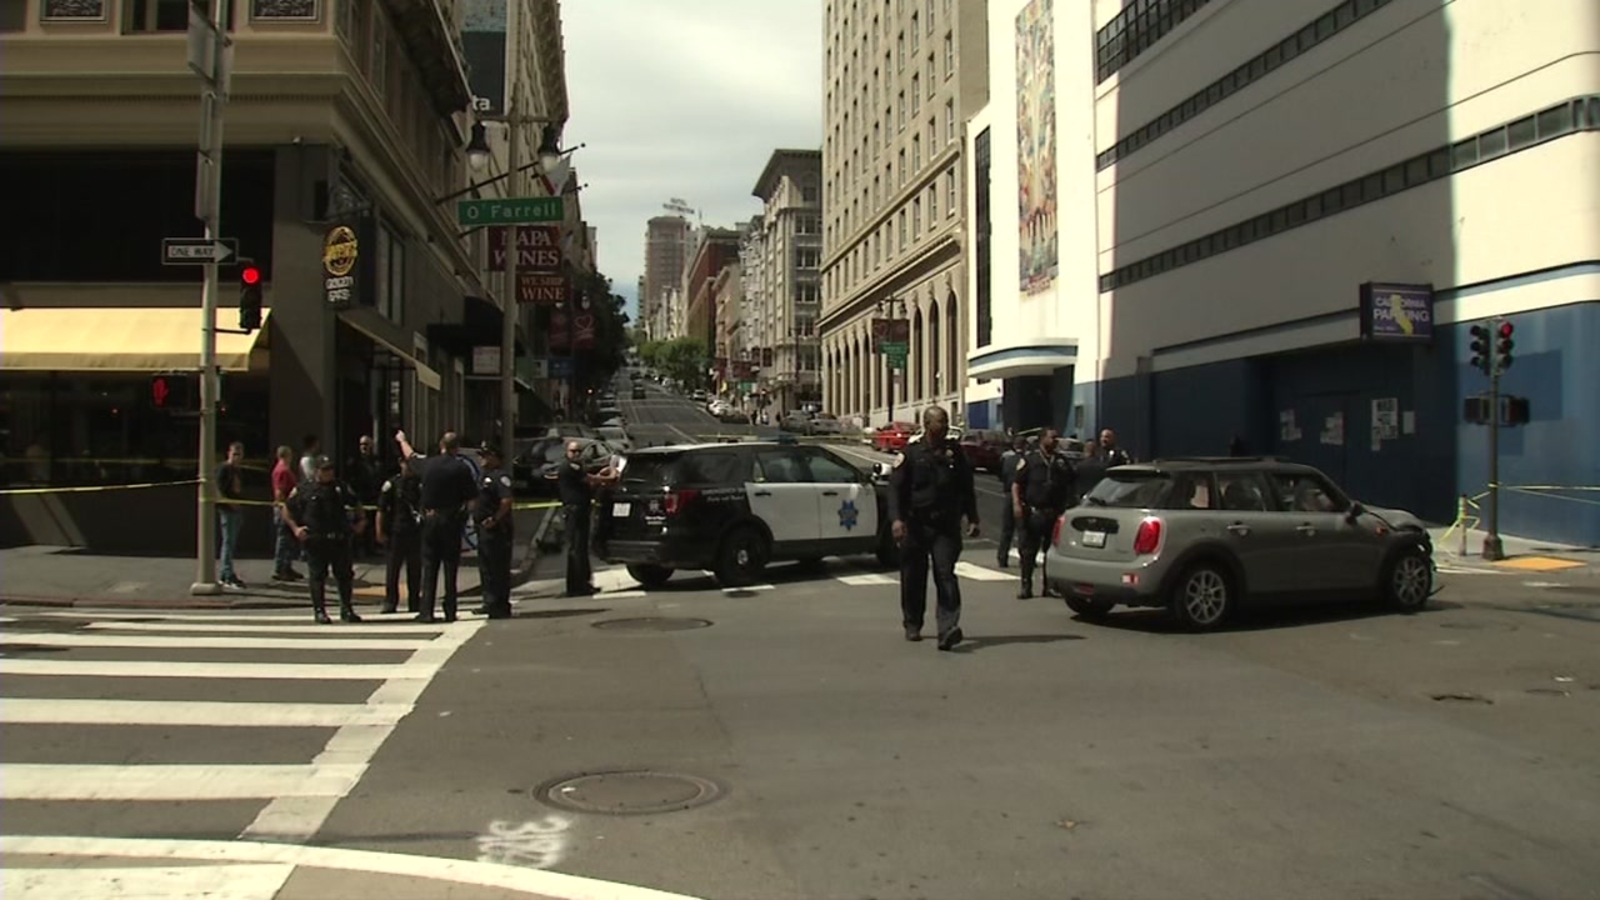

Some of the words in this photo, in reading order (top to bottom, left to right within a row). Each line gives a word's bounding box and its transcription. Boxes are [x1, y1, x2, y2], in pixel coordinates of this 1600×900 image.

[171, 248, 189, 256] ONE
[194, 248, 214, 256] WAY
[521, 287, 564, 300] WINE
